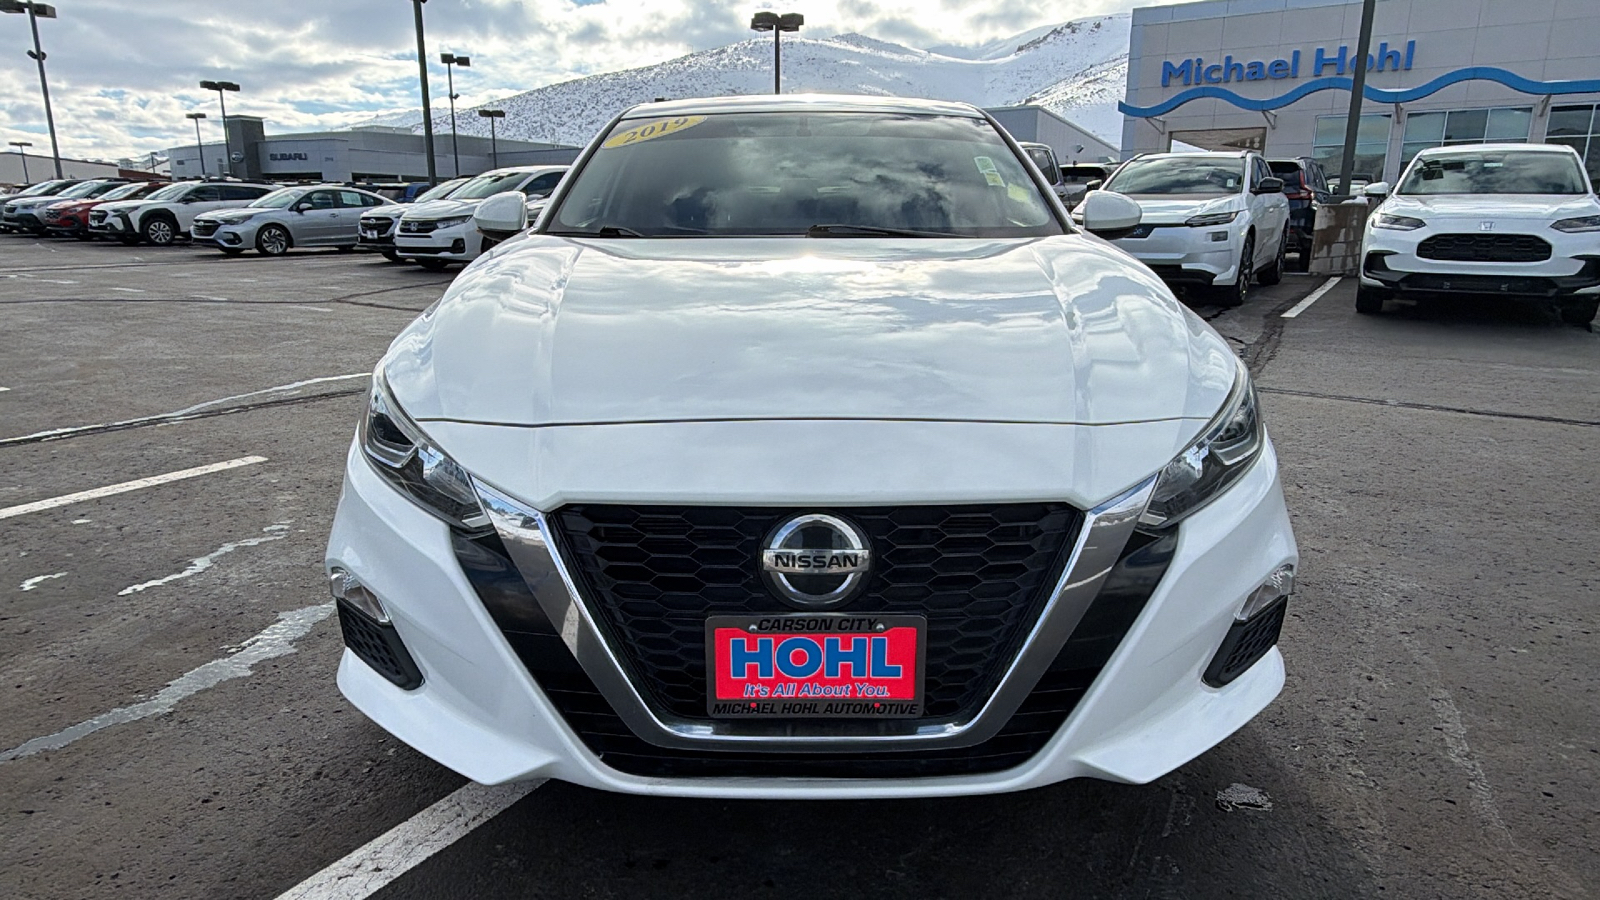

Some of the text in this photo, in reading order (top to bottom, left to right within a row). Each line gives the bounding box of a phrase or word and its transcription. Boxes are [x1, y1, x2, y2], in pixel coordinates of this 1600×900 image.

[1162, 40, 1416, 87] Michael Hohl
[623, 117, 689, 144] 2019
[269, 153, 308, 161] SUBARU
[774, 553, 859, 569] NISSAN
[757, 618, 879, 631] CARSON CITY
[730, 637, 903, 679] HOHL
[743, 682, 891, 697] It's All About You.
[712, 703, 919, 716] MICHAEL HOHL AUTOMOTIVE
